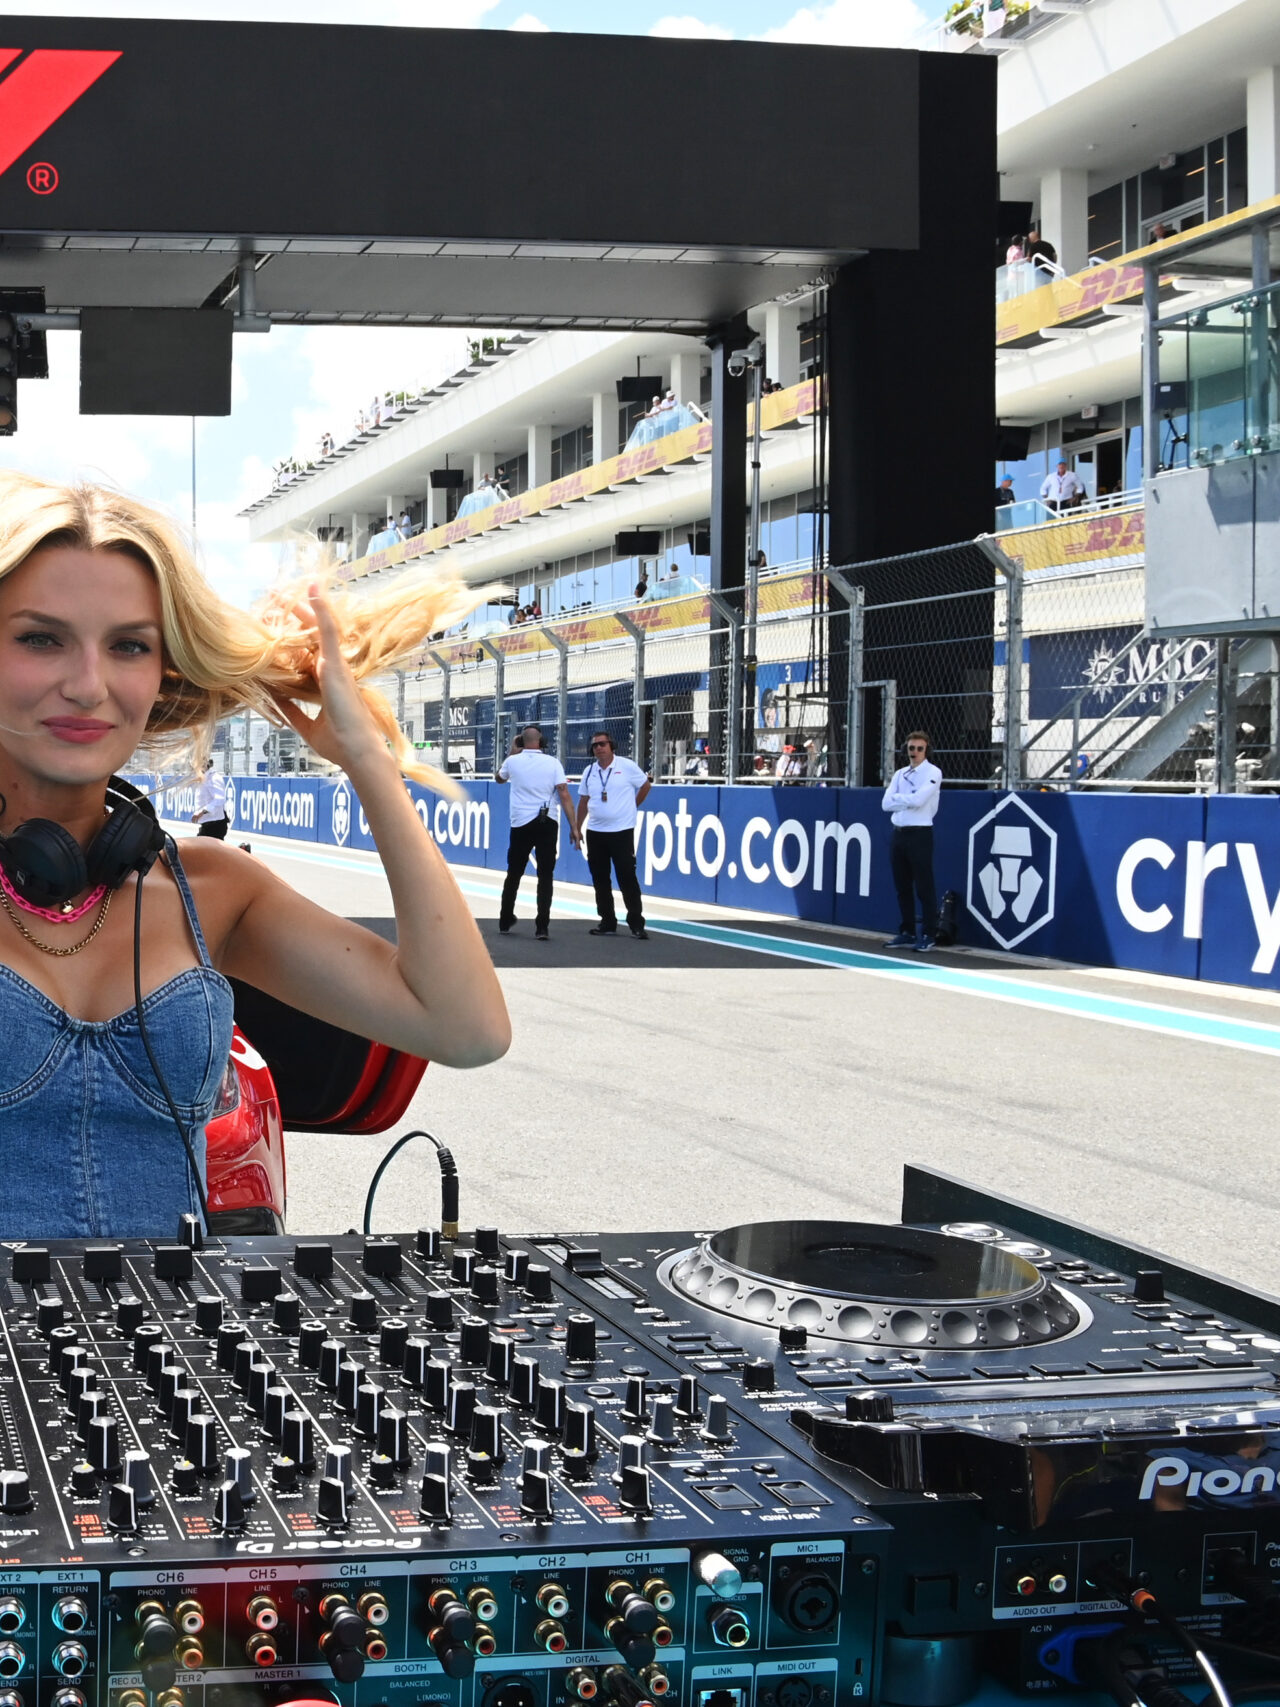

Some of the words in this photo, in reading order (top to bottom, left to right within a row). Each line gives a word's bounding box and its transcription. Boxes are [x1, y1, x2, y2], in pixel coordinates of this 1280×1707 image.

[1078, 267, 1144, 310] DH
[1085, 513, 1144, 551] DH
[240, 784, 315, 831] crypto.com
[1138, 1456, 1280, 1500] Pion
[733, 1555, 749, 1563] GND
[806, 1556, 841, 1564] BALANCED
[608, 1568, 635, 1576] PHONO
[649, 1566, 665, 1575] LINE
[15, 1574, 22, 1582] 2
[58, 1573, 77, 1581] EXT
[53, 1585, 89, 1594] RETURN
[181, 1587, 198, 1595] LINE
[254, 1584, 271, 1592] LINE
[1013, 1608, 1039, 1616] AUDIO
[1040, 1606, 1056, 1615] OUT
[1079, 1603, 1108, 1612] DIGITAL
[1030, 1625, 1042, 1633] AC
[1043, 1624, 1053, 1632] IN
[565, 1655, 600, 1664] DIGITAL
[394, 1664, 427, 1673] BOOTH
[712, 1667, 733, 1676] LINK
[777, 1663, 797, 1672] MIDI
[799, 1662, 816, 1671] OUT
[255, 1670, 293, 1679] MASTER
[57, 1677, 81, 1686] SEND
[111, 1677, 129, 1686] REC
[390, 1679, 431, 1688] BALANCED
